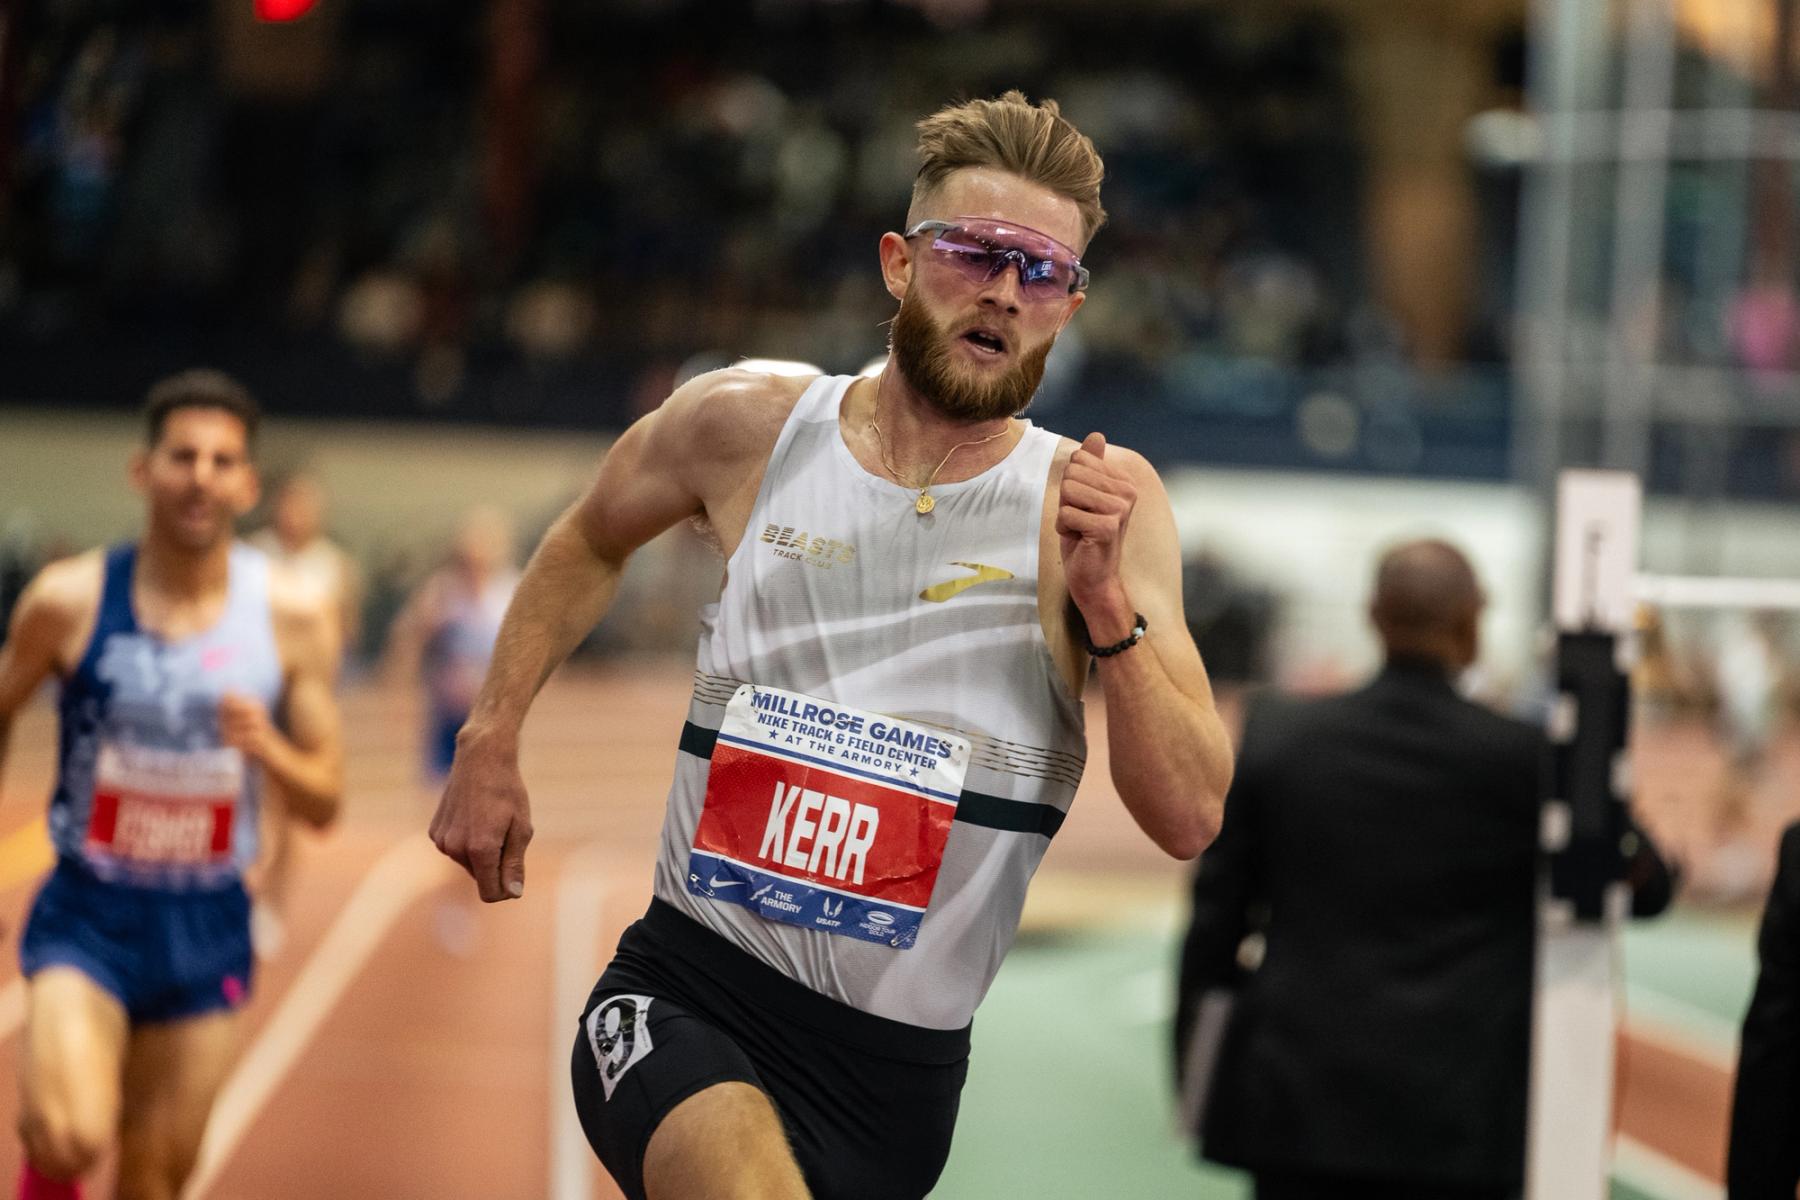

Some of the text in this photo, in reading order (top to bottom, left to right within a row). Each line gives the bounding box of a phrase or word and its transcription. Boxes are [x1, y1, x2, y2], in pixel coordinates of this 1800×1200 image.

[773, 549, 802, 561] TRACK
[752, 691, 953, 759] MILLROSE GAMES
[758, 713, 937, 770] NIKE TRACK & FIELD CENTER
[785, 735, 902, 772] AT THE ARMORY
[757, 780, 880, 886] KERR
[760, 896, 802, 914] ARMORY
[775, 890, 793, 902] THE
[595, 997, 638, 1080] 9
